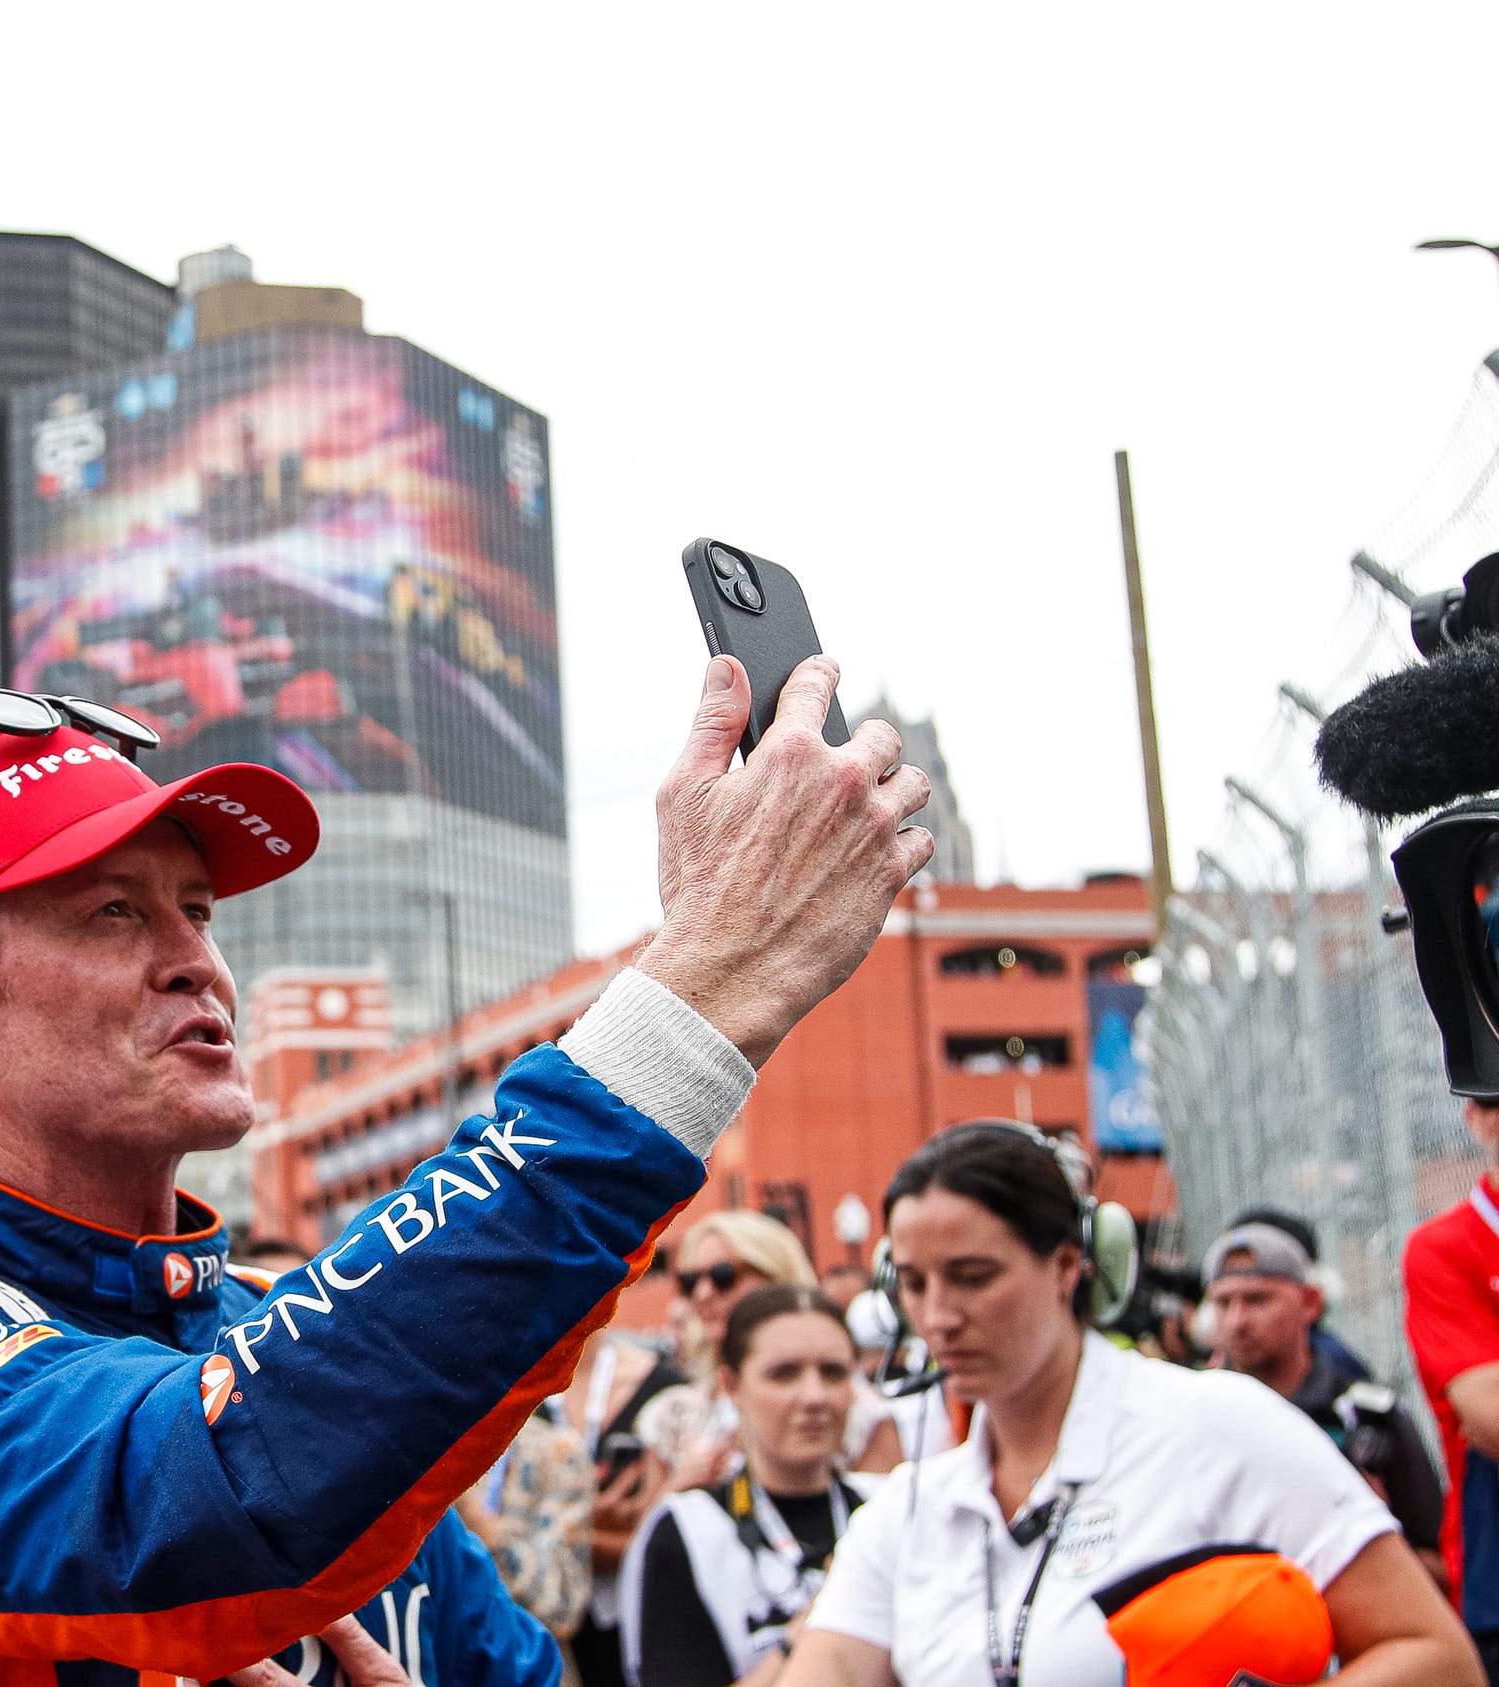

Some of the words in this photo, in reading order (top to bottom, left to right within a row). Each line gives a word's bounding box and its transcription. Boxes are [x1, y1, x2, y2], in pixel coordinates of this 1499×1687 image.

[193, 1250, 229, 1292] PN
[224, 1232, 383, 1375] PNC
[367, 1108, 557, 1255] BANK
